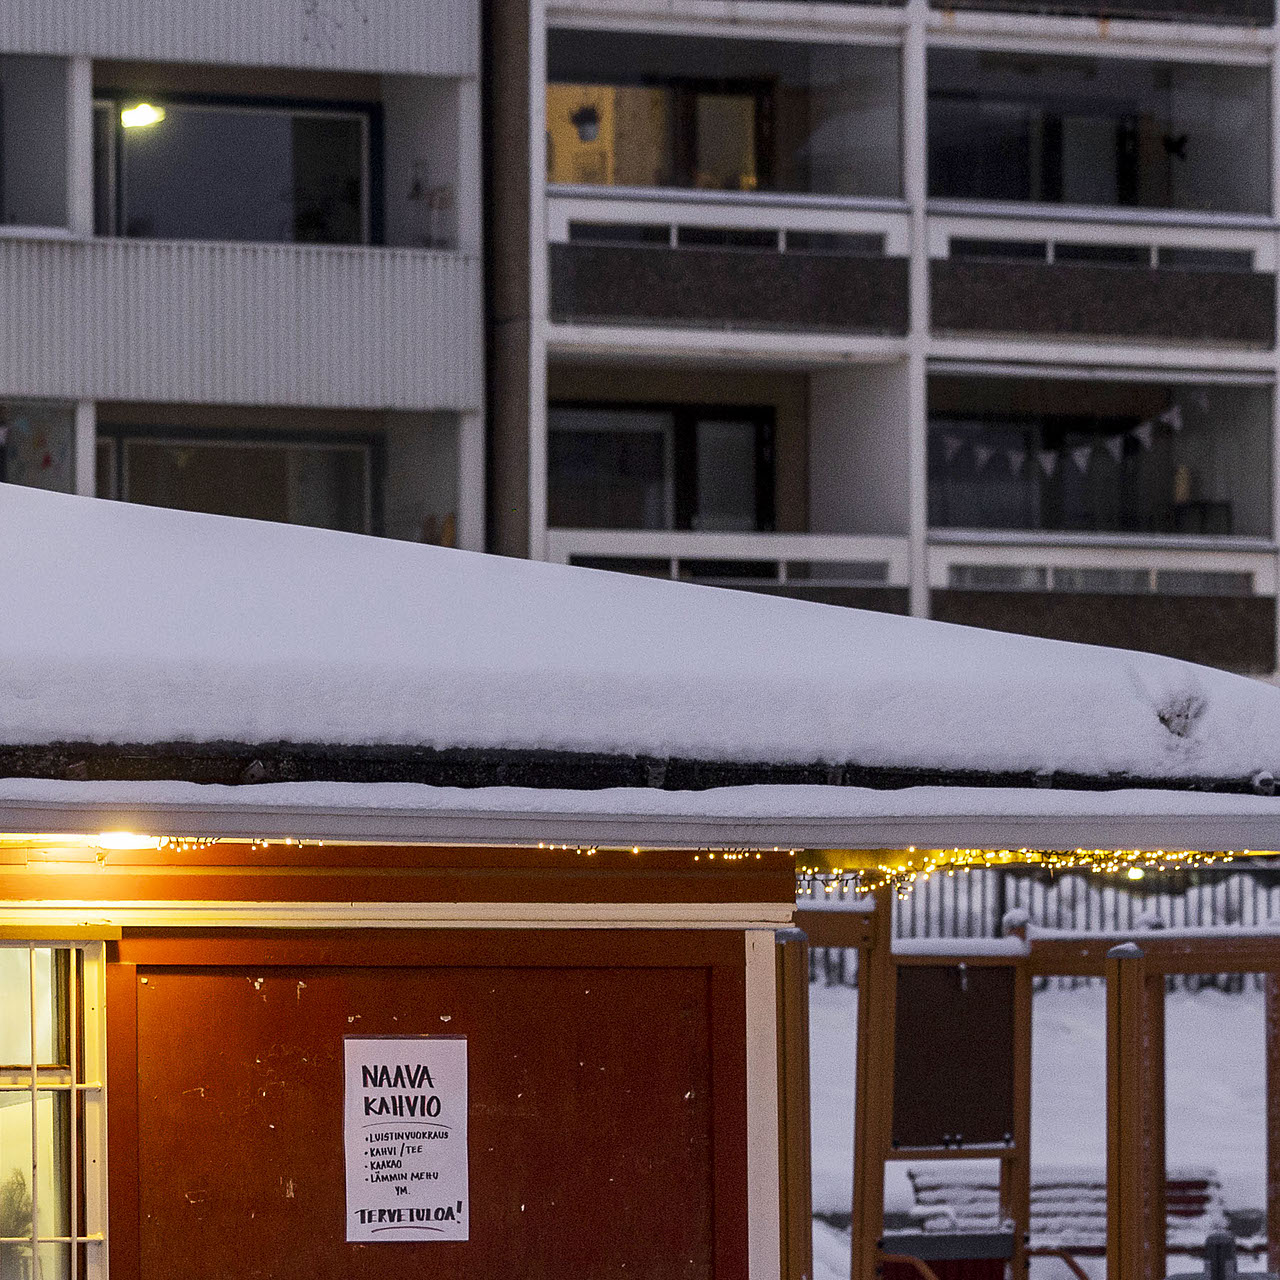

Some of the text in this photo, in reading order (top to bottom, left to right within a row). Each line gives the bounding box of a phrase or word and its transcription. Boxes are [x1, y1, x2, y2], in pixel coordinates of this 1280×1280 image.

[361, 1064, 434, 1089] NAAVA
[364, 1095, 441, 1118] KAHVIO
[369, 1131, 449, 1143] LUISTINVUOKRAUS
[370, 1160, 402, 1170] KAAKAO
[370, 1171, 439, 1183] LÄMMIN MEHU
[354, 1200, 463, 1225] TERVETULOA!
